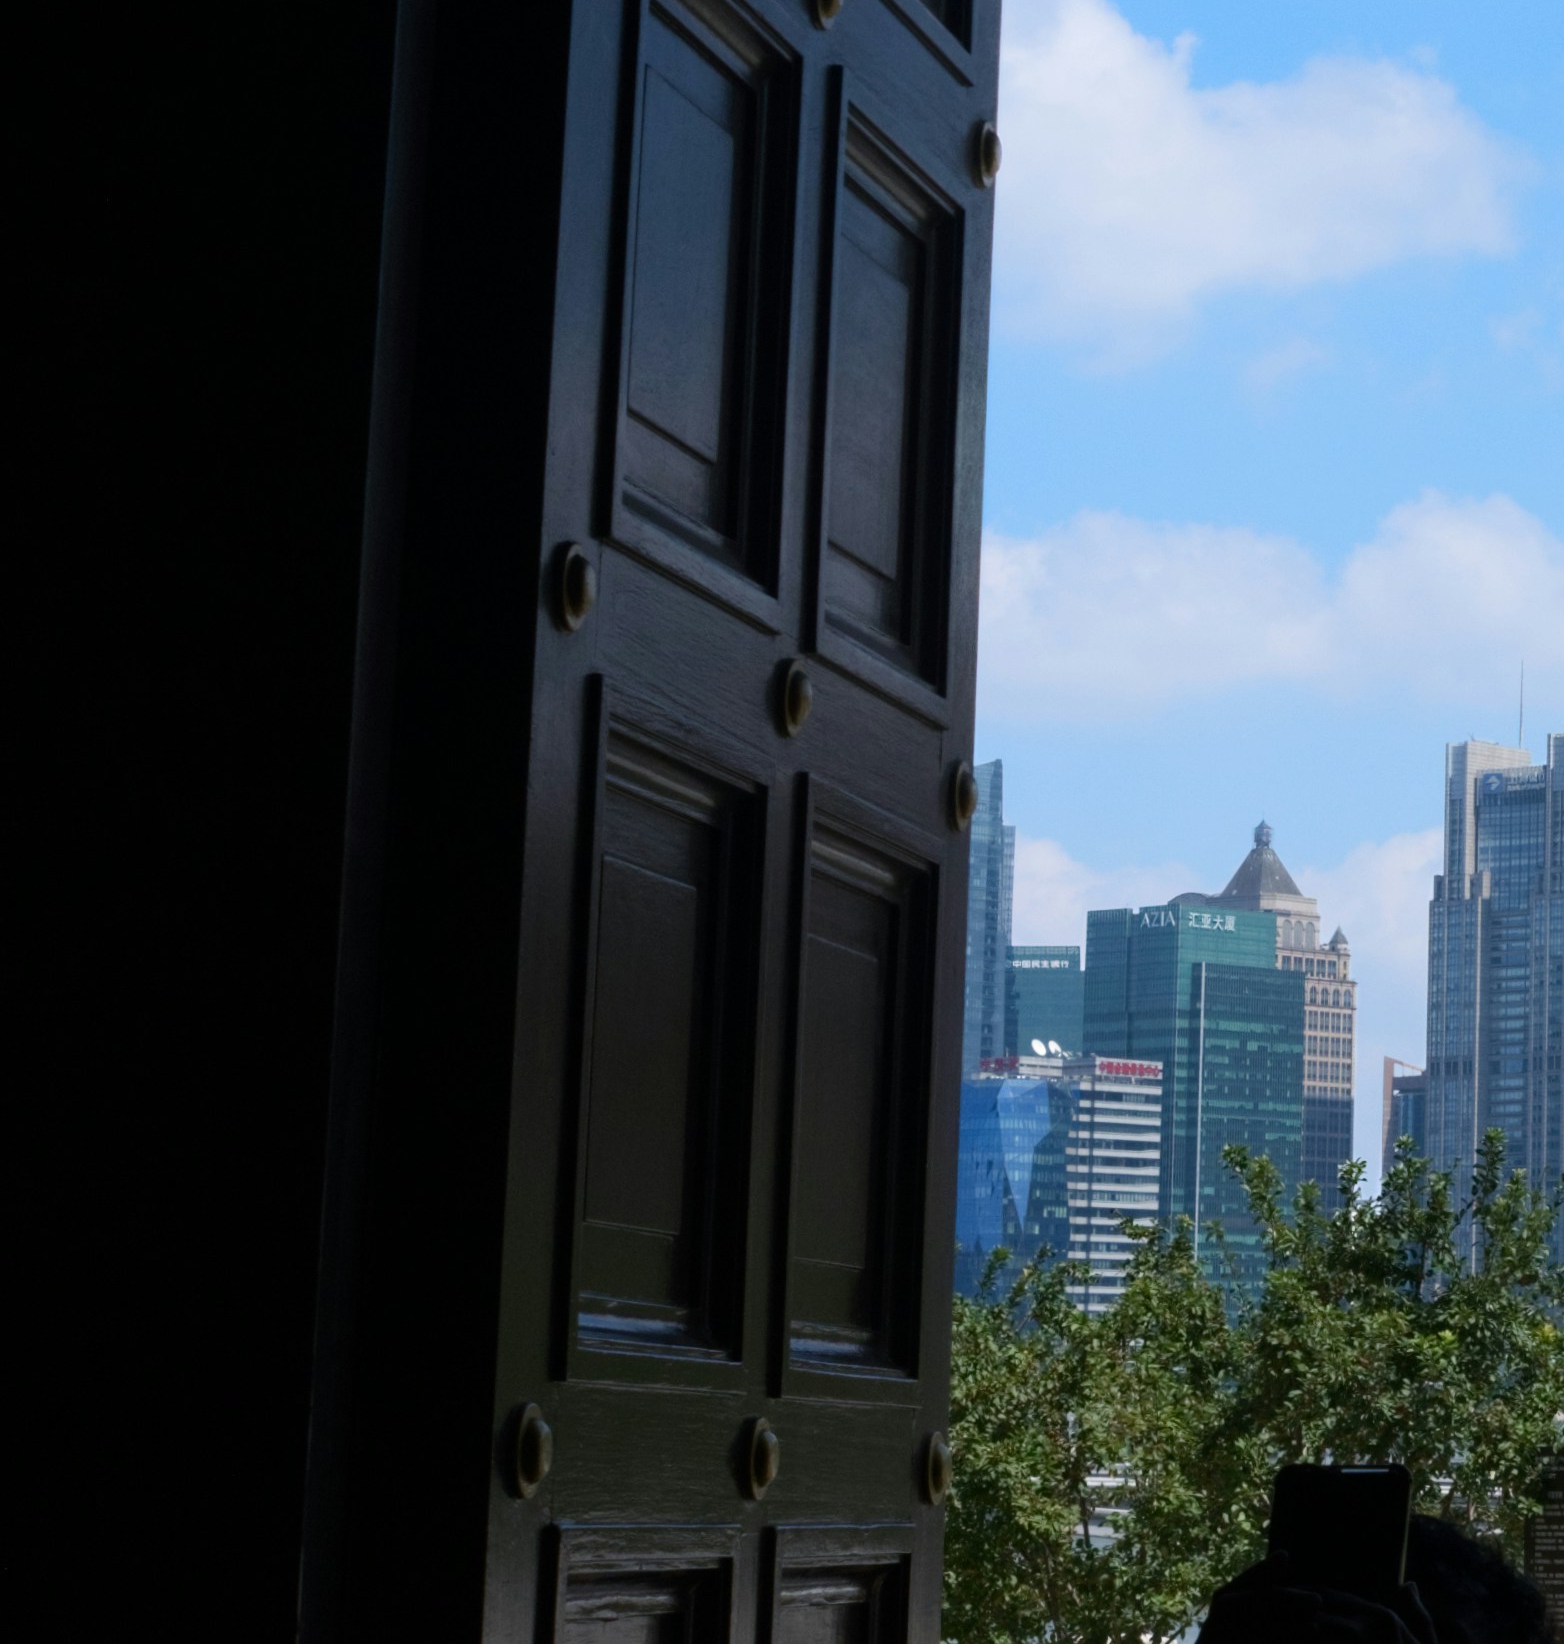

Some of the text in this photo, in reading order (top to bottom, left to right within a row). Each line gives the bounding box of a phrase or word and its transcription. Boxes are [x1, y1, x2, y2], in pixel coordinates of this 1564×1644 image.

[1140, 910, 1176, 928] AZIA
[1188, 911, 1236, 932] 汇亚大厦
